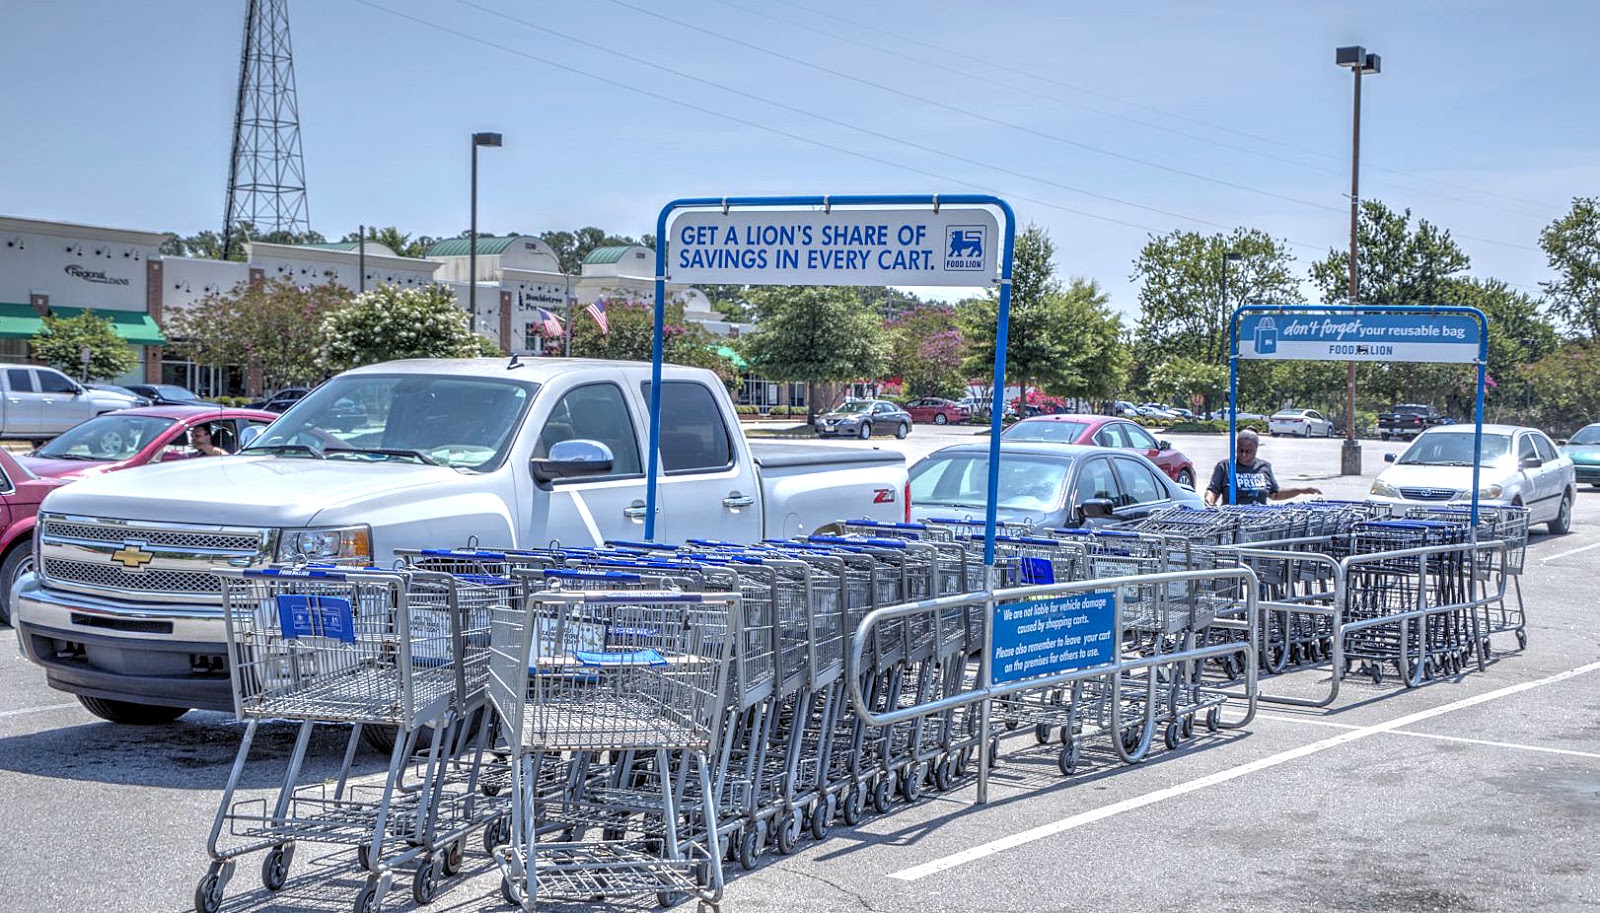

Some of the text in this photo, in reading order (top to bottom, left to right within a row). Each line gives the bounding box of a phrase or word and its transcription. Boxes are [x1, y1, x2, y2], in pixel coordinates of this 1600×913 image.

[680, 225, 927, 246] GET A LION'S SHARE OF
[679, 249, 935, 271] SAVINGS IN EVERY CART.
[946, 260, 983, 269] FOOD LION
[1283, 318, 1466, 341] don't forget your reusable bag
[1328, 345, 1393, 355] FOOD LION
[1237, 478, 1266, 488] PRIDE
[1003, 597, 1107, 621] We are not liable for vehicle damage
[1017, 615, 1090, 635] caused by shopping carts.
[995, 630, 1111, 659] Please also remember to leave your cart
[1004, 647, 1100, 673] on the premises for others to use.
